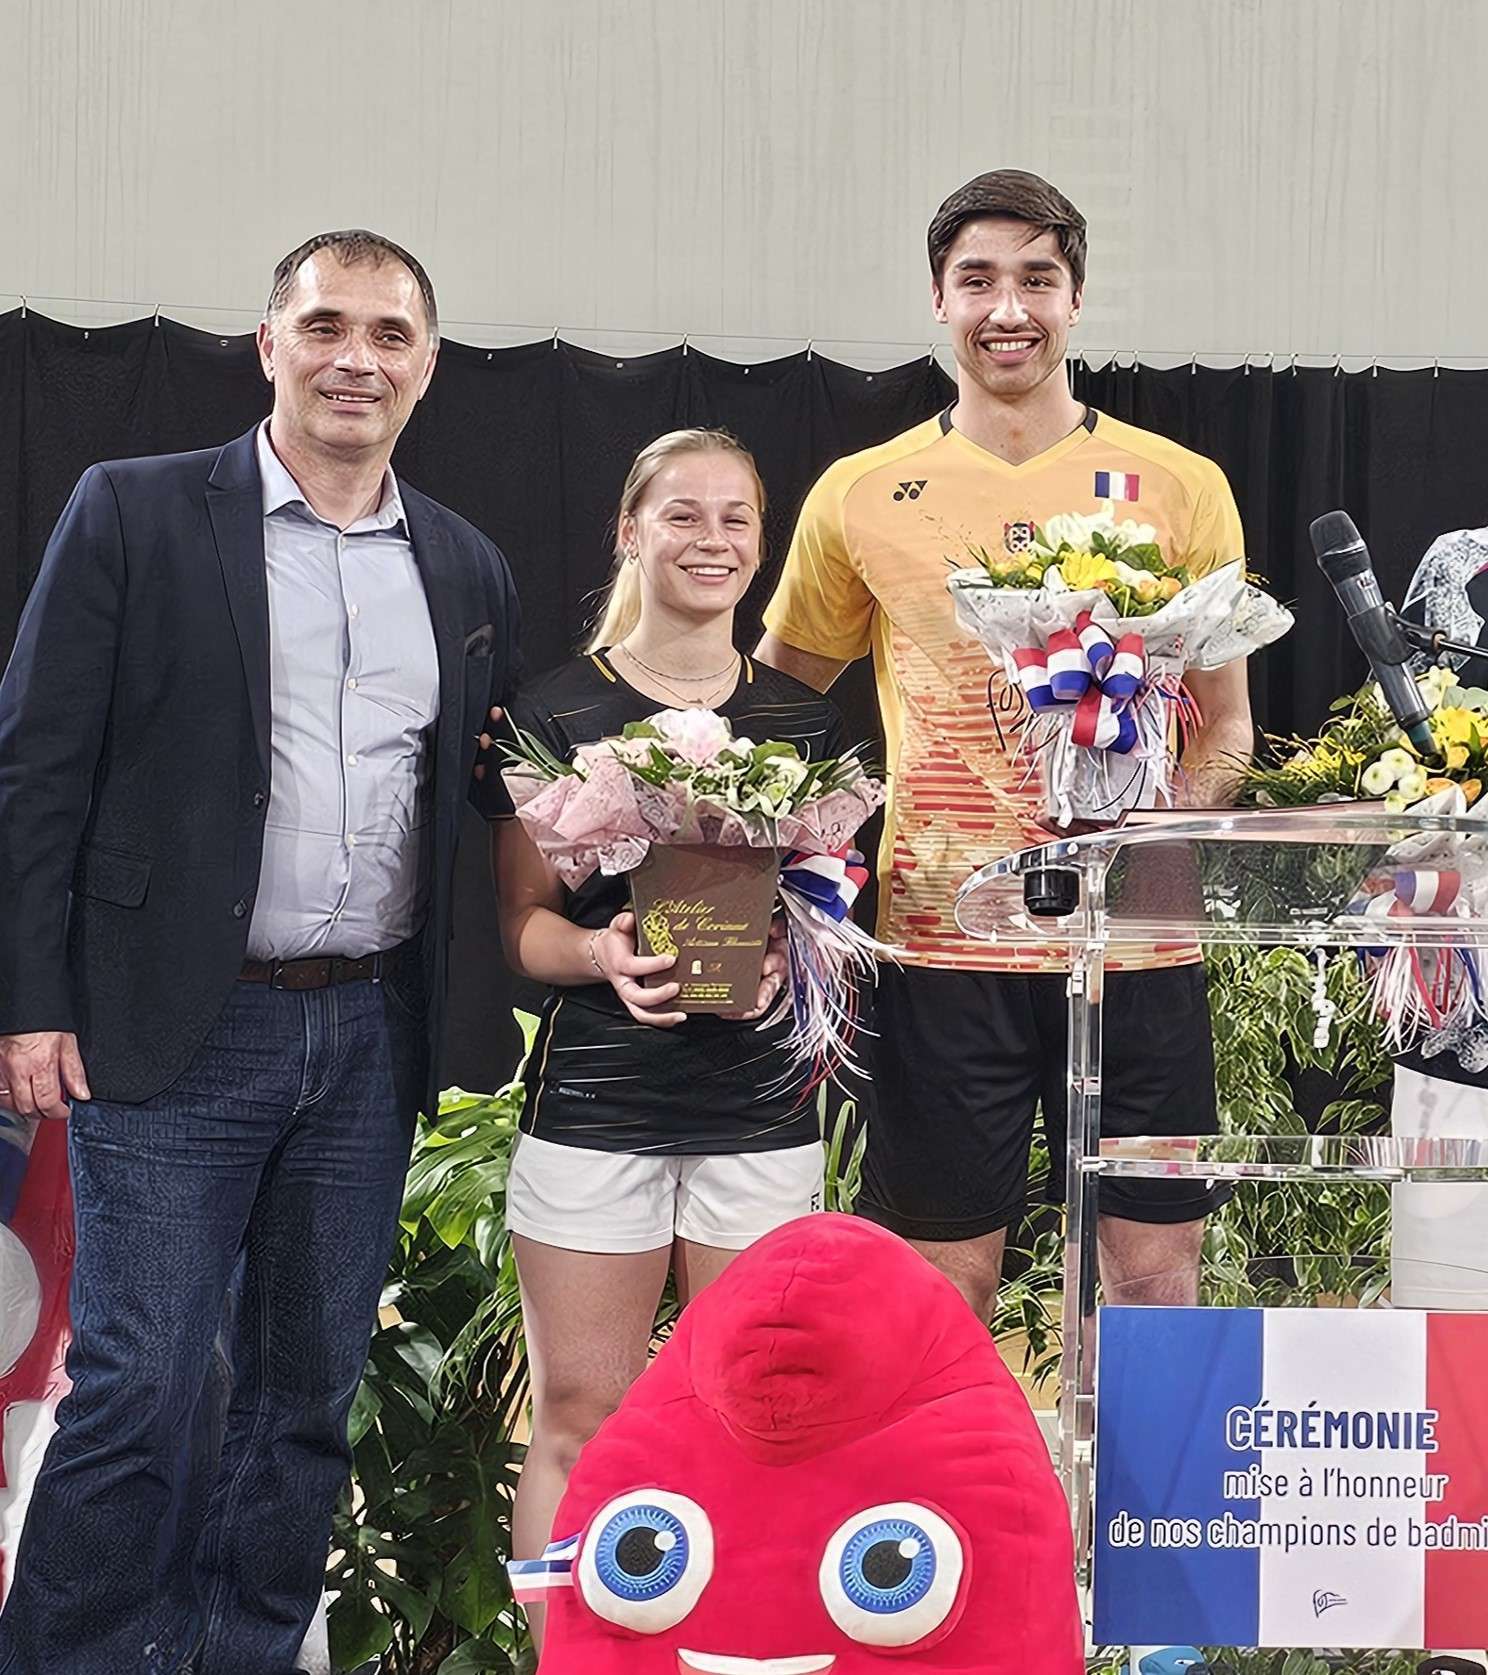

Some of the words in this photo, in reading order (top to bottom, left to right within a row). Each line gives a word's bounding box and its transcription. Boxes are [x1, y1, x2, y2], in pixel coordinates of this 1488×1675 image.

[1228, 1400, 1437, 1450] CÉRÉMONIE
[1226, 1465, 1289, 1498] mise
[1299, 1466, 1313, 1497] à
[1323, 1467, 1447, 1499] l'honneur
[1111, 1513, 1142, 1544] de
[1153, 1519, 1199, 1545] nos
[1209, 1515, 1357, 1552] champions
[1367, 1516, 1397, 1547] de
